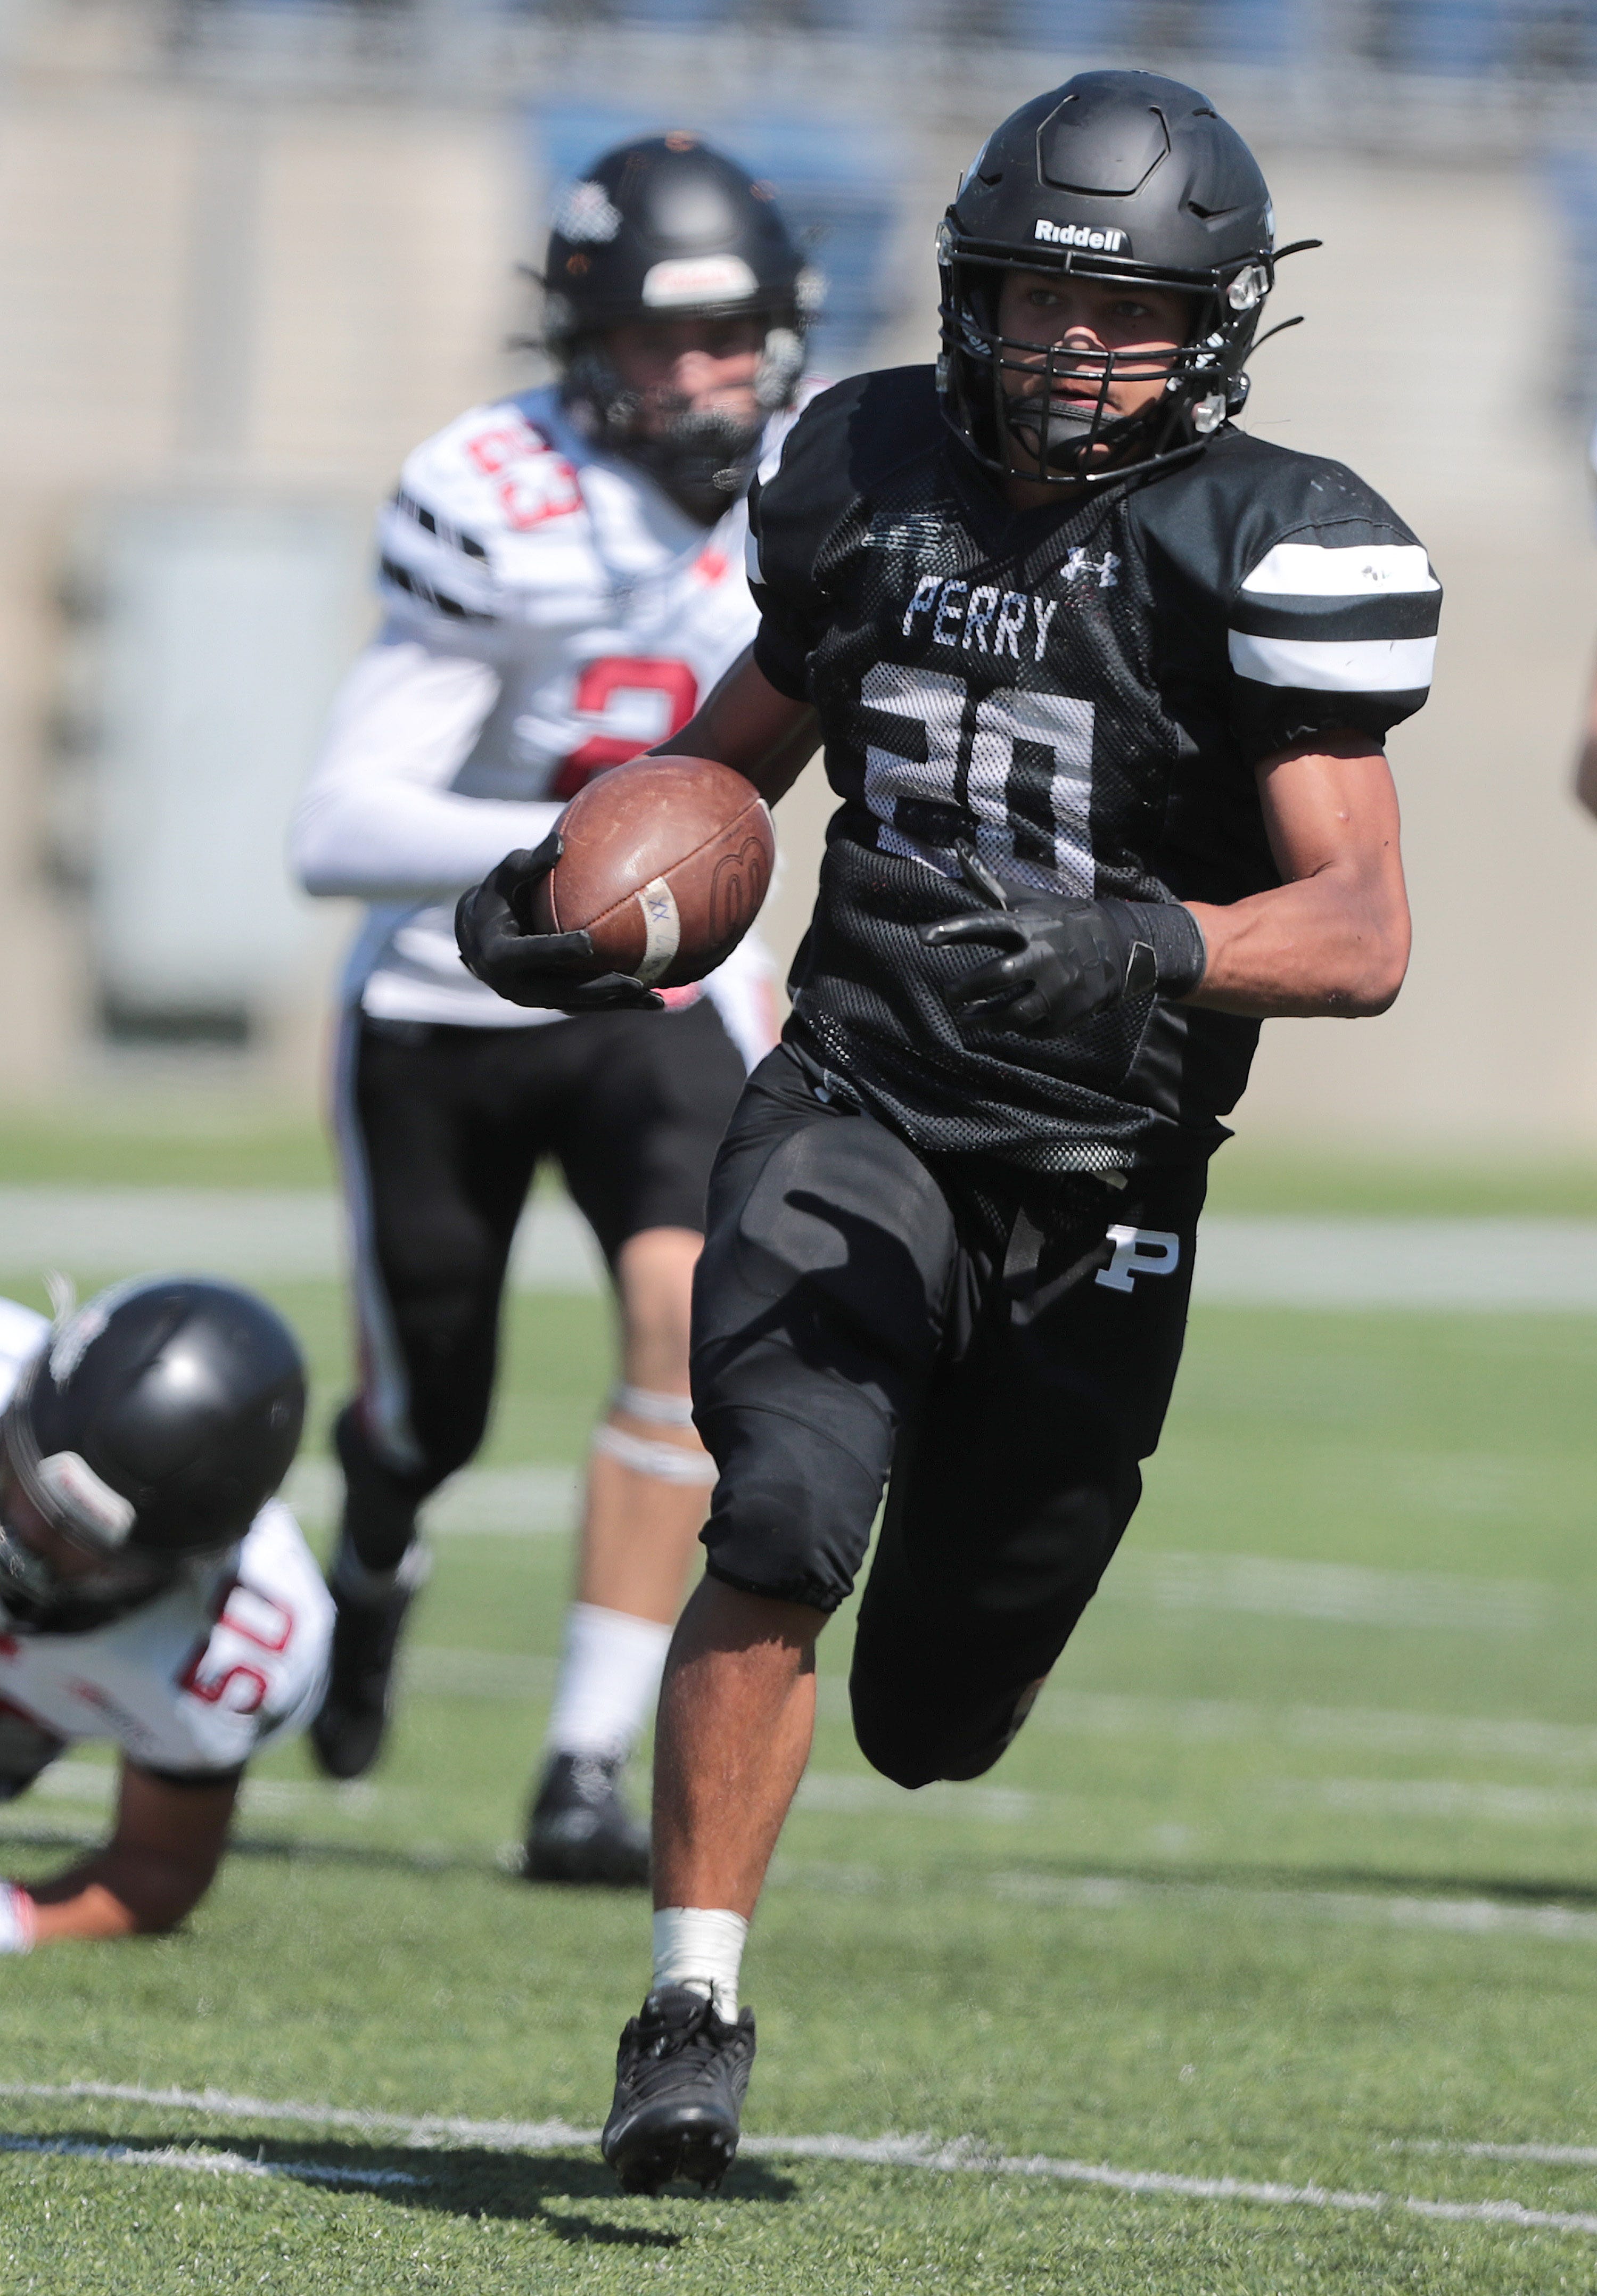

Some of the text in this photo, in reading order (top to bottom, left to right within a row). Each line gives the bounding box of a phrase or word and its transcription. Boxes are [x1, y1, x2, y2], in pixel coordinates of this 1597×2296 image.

[1034, 219, 1121, 252] Riddell
[902, 574, 1058, 662] PERRY
[860, 660, 1096, 901] 20
[1094, 1224, 1179, 1293] P
